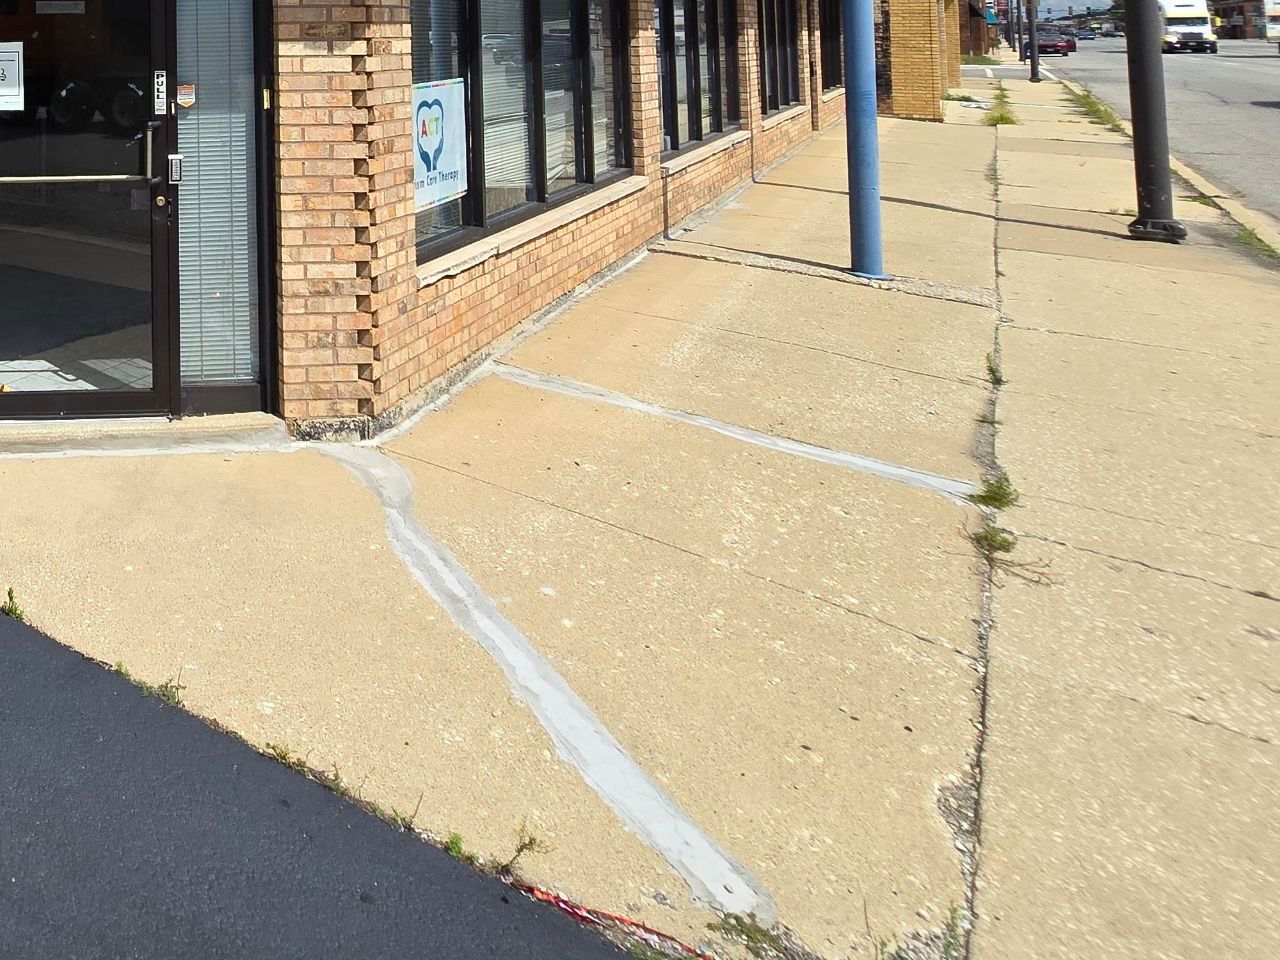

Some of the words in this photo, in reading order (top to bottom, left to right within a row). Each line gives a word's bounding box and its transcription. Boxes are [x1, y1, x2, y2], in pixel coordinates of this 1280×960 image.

[155, 73, 165, 100] PULL
[421, 116, 440, 138] ACT
[427, 175, 437, 186] Care
[438, 170, 459, 182] Therapy
